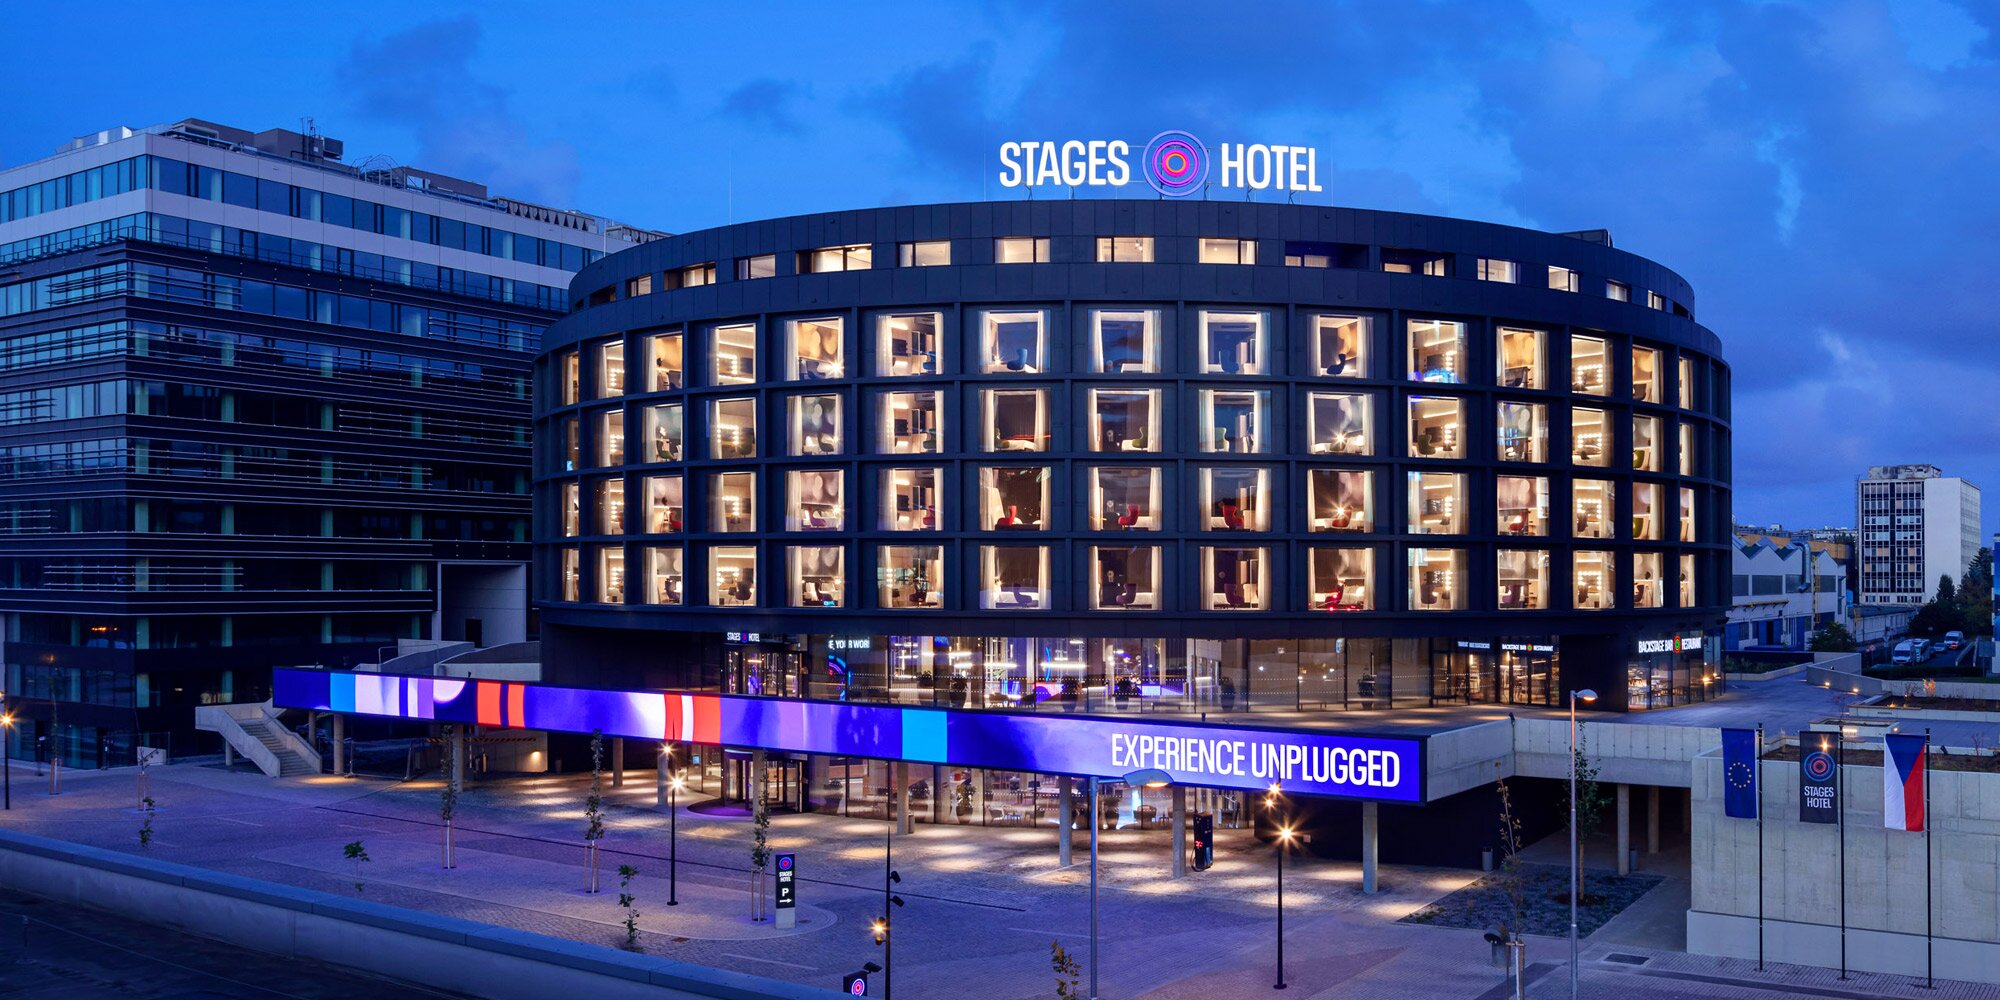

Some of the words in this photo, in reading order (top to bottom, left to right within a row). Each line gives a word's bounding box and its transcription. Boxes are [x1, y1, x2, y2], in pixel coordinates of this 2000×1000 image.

[999, 140, 1129, 188] STAGES
[1221, 143, 1323, 192] HOTEL
[727, 632, 741, 641] STAGES
[748, 633, 760, 642] HOTEL
[1638, 639, 1664, 653] BACKSTAGE
[1665, 639, 1673, 651] BAR
[1681, 637, 1702, 650] RESTAURANT
[1111, 733, 1246, 776] EXPERIENCE
[1251, 742, 1400, 788] UNPLUGGED
[1804, 786, 1834, 798] STAGES
[1807, 797, 1832, 809] HOTEL
[782, 888, 789, 897] P
